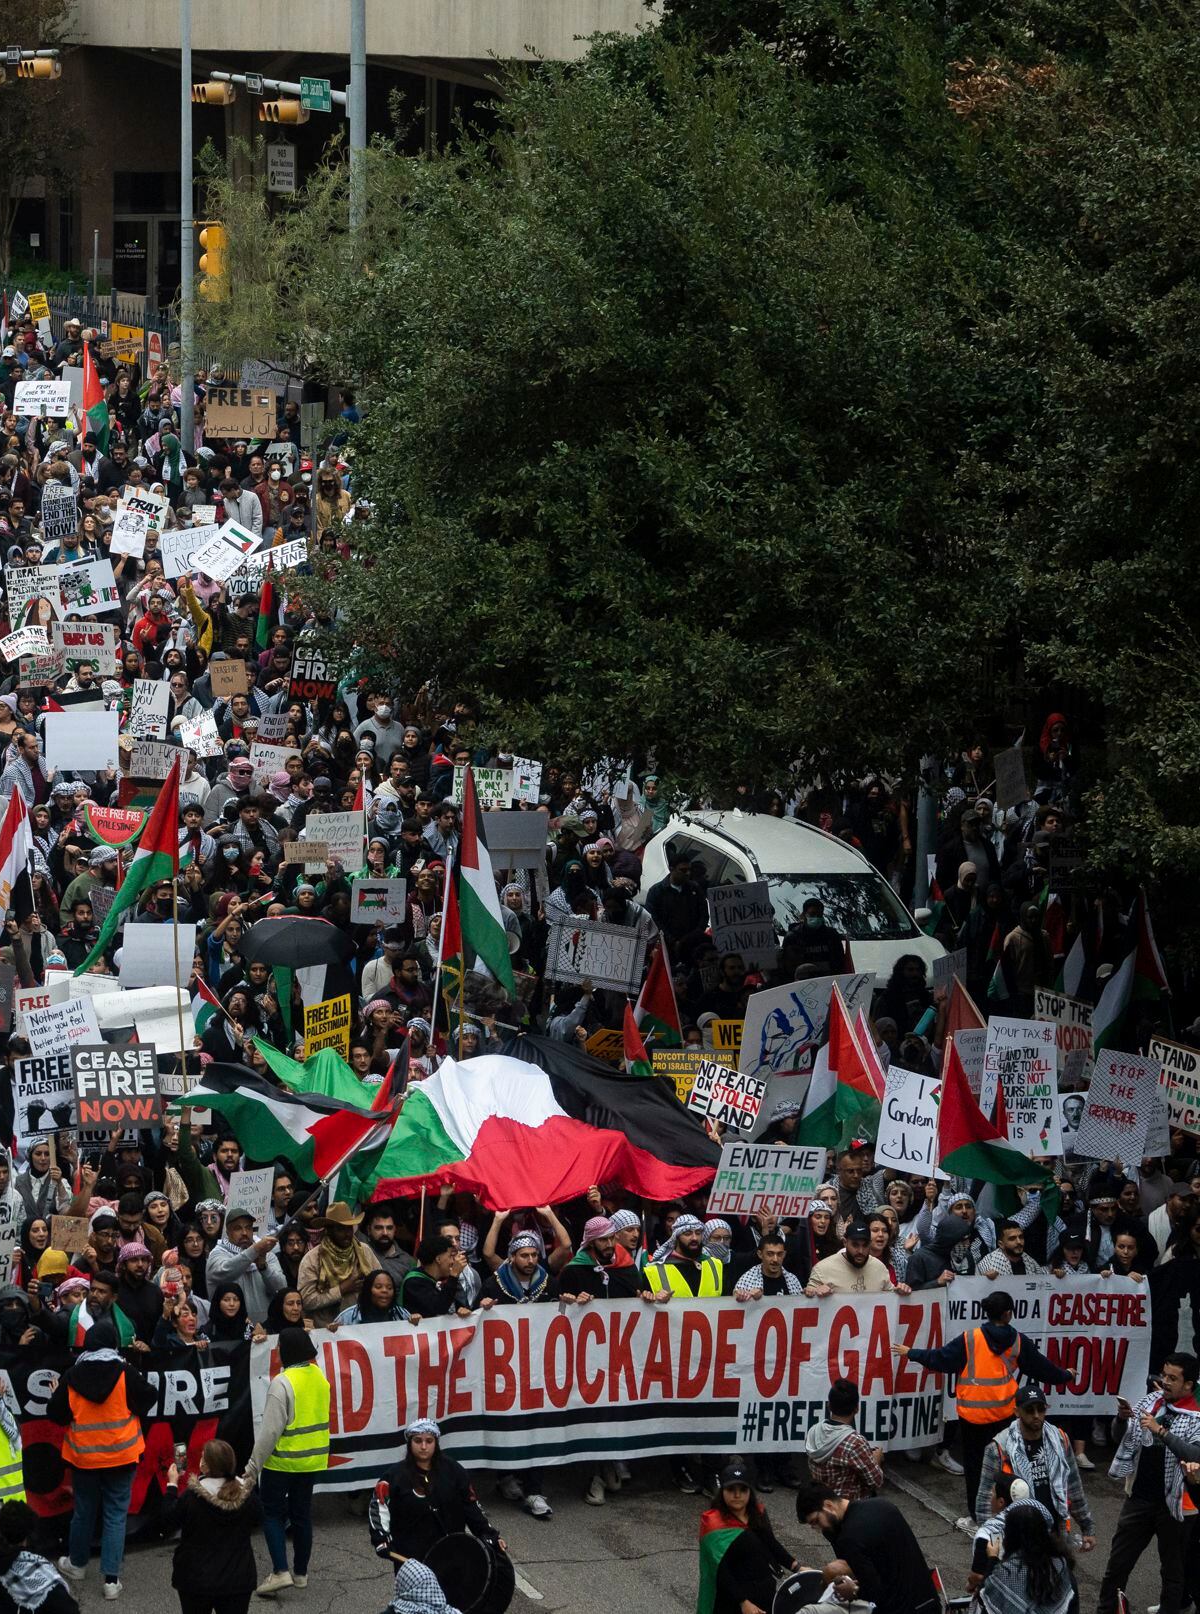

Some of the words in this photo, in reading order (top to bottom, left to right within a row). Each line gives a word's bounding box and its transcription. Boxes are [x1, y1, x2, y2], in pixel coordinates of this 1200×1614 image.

[208, 388, 252, 407] FREE
[44, 511, 60, 521] END
[62, 508, 76, 518] THE
[128, 497, 164, 514] PRAY
[45, 522, 76, 538] NOW!
[198, 541, 221, 564] STOP
[16, 567, 42, 577] ISRAEL
[1, 630, 25, 646] FROM
[27, 628, 44, 636] THE
[88, 632, 105, 646] US
[135, 681, 158, 696] WHY
[135, 695, 153, 706] YOU
[91, 807, 107, 818] FREE
[109, 809, 125, 820] FREE
[126, 811, 141, 822] FREE
[97, 820, 135, 832] PALESTINE
[1036, 991, 1067, 1016] STOP
[306, 1005, 331, 1025] FREE
[332, 1001, 349, 1016] ALL
[306, 1017, 349, 1039] PALESTINIAN
[75, 1049, 154, 1070] CEASE
[652, 1052, 686, 1062] BOYCOTT
[1022, 1046, 1039, 1060] YOU
[1150, 1041, 1197, 1071] STAND
[20, 1055, 71, 1084] FREE
[652, 1062, 667, 1071] PRO
[1032, 1059, 1052, 1071] KILL
[1108, 1063, 1145, 1081] STOP
[76, 1069, 156, 1097] FIRE
[699, 1060, 716, 1080] NO
[717, 1066, 766, 1100] PEACE
[1017, 1074, 1026, 1084] IS
[1027, 1072, 1045, 1084] NOT
[18, 1078, 75, 1097] PALESTINE
[696, 1077, 712, 1091] ON
[711, 1082, 760, 1116] STOLEN
[1027, 1084, 1051, 1097] LAND
[1108, 1084, 1136, 1100] THE
[1039, 1099, 1053, 1110] TO
[706, 1100, 755, 1131] LAND
[1017, 1112, 1037, 1124] FOR
[716, 1170, 818, 1193] PALESTINIAN
[949, 1300, 968, 1320] WE
[1031, 1298, 1041, 1319] A
[1049, 1293, 1148, 1328] CEASEFIRE
[383, 1325, 476, 1427] THE
[483, 1309, 746, 1412] BLOCKADE
[753, 1306, 821, 1399] OF
[827, 1301, 944, 1397] GAZA
[1046, 1336, 1130, 1397] NOW
